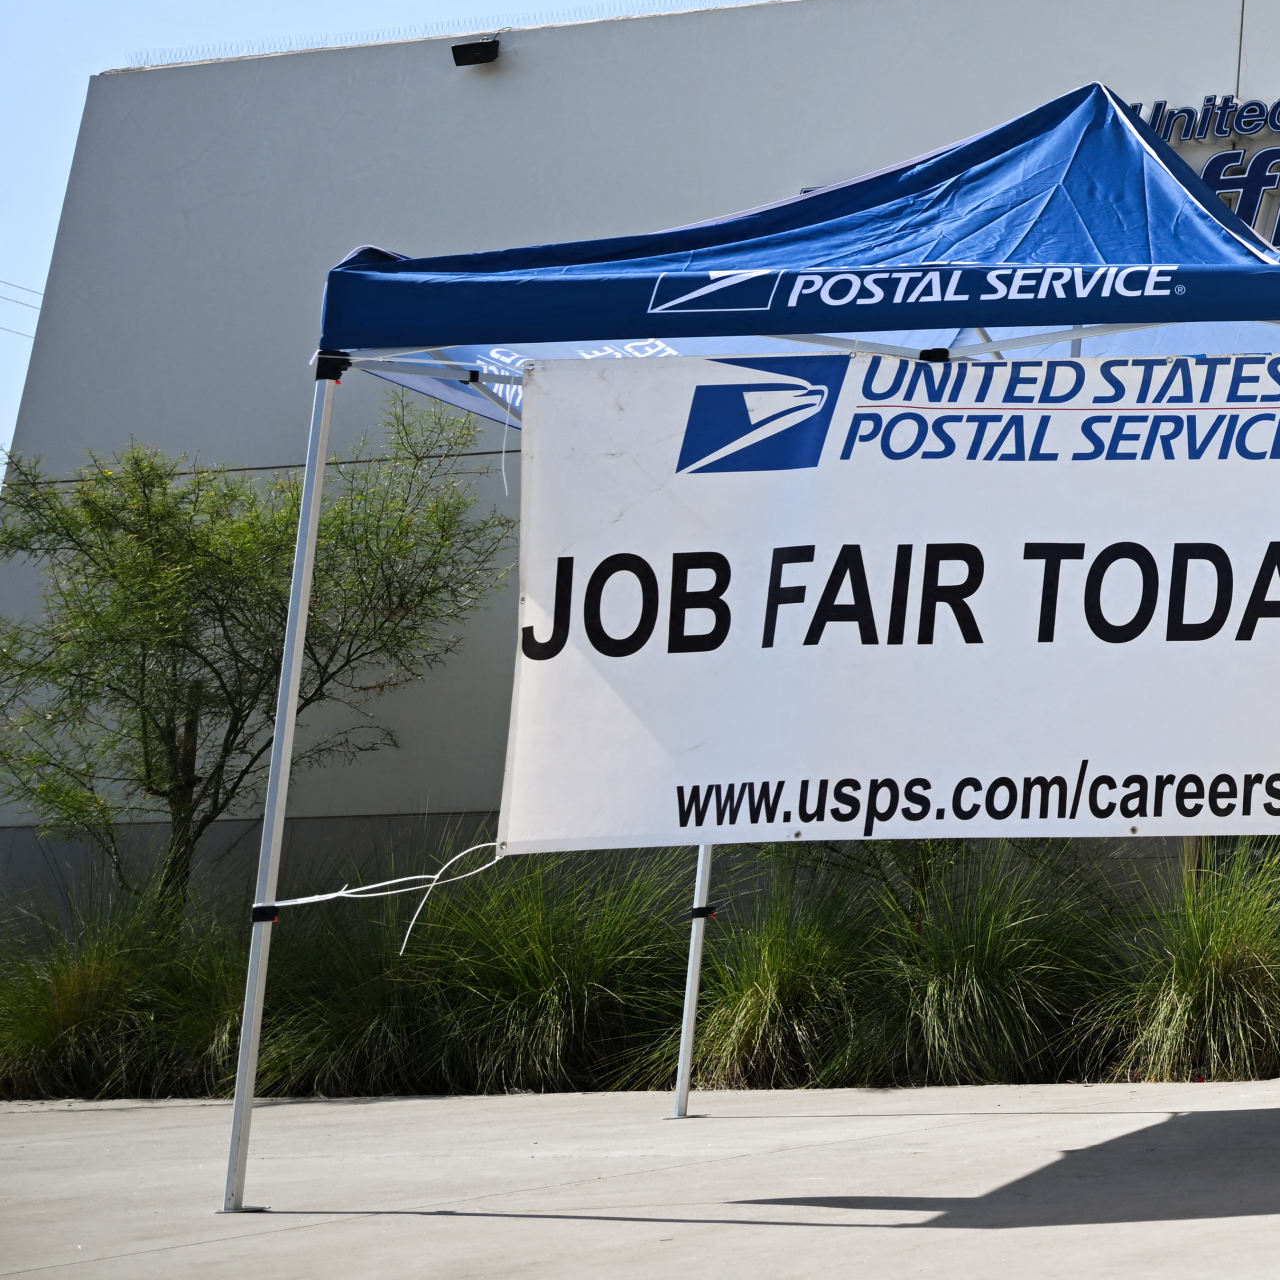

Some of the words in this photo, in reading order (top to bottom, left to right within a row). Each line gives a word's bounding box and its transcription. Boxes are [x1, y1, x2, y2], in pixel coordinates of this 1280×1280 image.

[788, 271, 970, 307] POSTAL
[980, 266, 1179, 301] SERVICE
[862, 356, 1085, 403] UNITED
[840, 412, 1060, 461] POSTAL
[522, 552, 731, 661] JOB
[762, 543, 984, 648] FAIR
